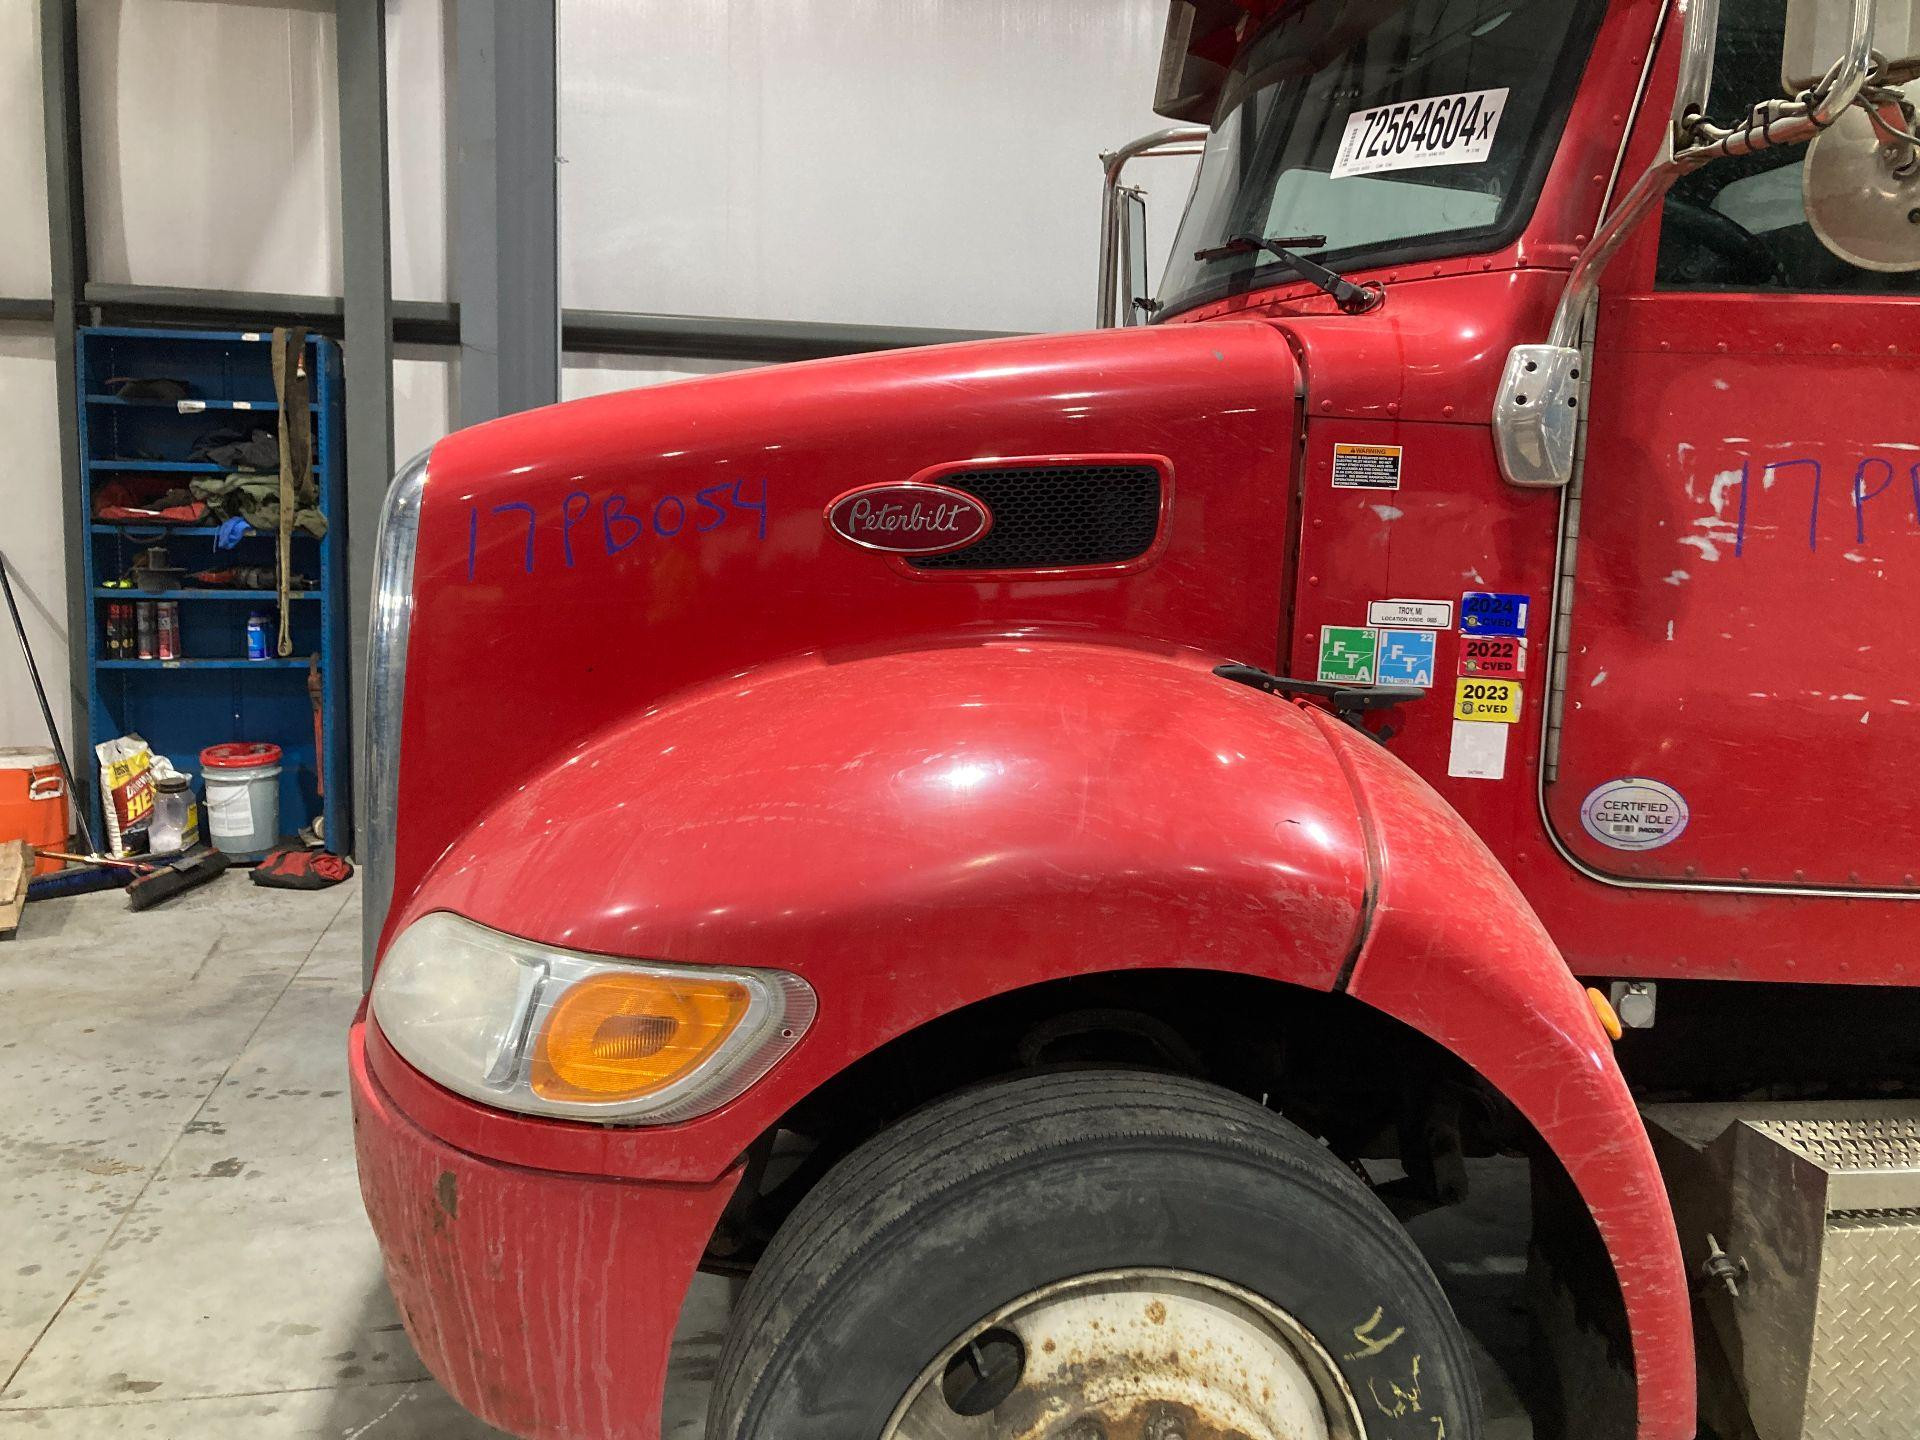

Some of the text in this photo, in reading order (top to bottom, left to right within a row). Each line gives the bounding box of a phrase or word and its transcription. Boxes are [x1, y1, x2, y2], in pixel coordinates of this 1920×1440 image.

[1356, 447, 1386, 455] WARNING
[848, 498, 971, 534] Peterbilt
[1468, 597, 1513, 613] 2024
[1415, 607, 1423, 615] MI
[1482, 617, 1513, 628] CVED
[1361, 630, 1375, 639] 23
[1419, 633, 1433, 643] 22
[1466, 642, 1514, 658] 2022
[1482, 661, 1512, 671] CVED
[1463, 684, 1509, 701] 2023
[1477, 704, 1508, 714] CVED
[1603, 800, 1669, 813] CERTIFIED
[1596, 812, 1673, 825] CLEAN IDLE
